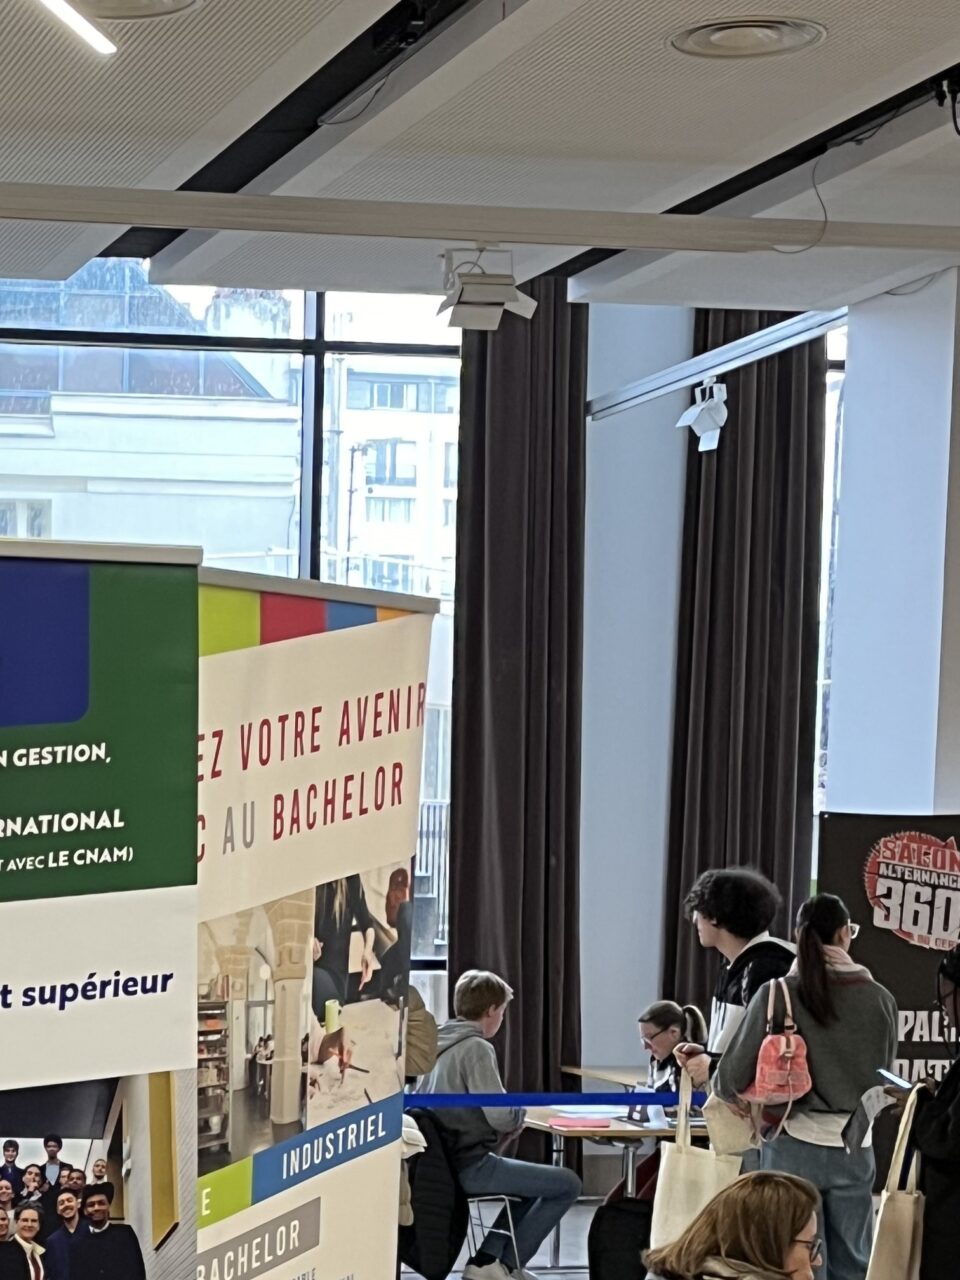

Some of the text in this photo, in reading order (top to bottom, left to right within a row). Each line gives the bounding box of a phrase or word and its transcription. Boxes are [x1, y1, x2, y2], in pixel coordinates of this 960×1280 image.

[13, 743, 111, 767] GESTION,
[240, 706, 322, 771] VOTRE
[339, 682, 425, 747] AVENIR
[223, 801, 255, 854] AU
[273, 762, 402, 840] BACHELOR
[6, 856, 45, 872] AVEC
[48, 851, 69, 868] LE
[73, 847, 134, 865] CNAM)
[873, 878, 960, 939] 360
[22, 969, 173, 1012] supérieur
[283, 1112, 386, 1179] INDUSTRIEL
